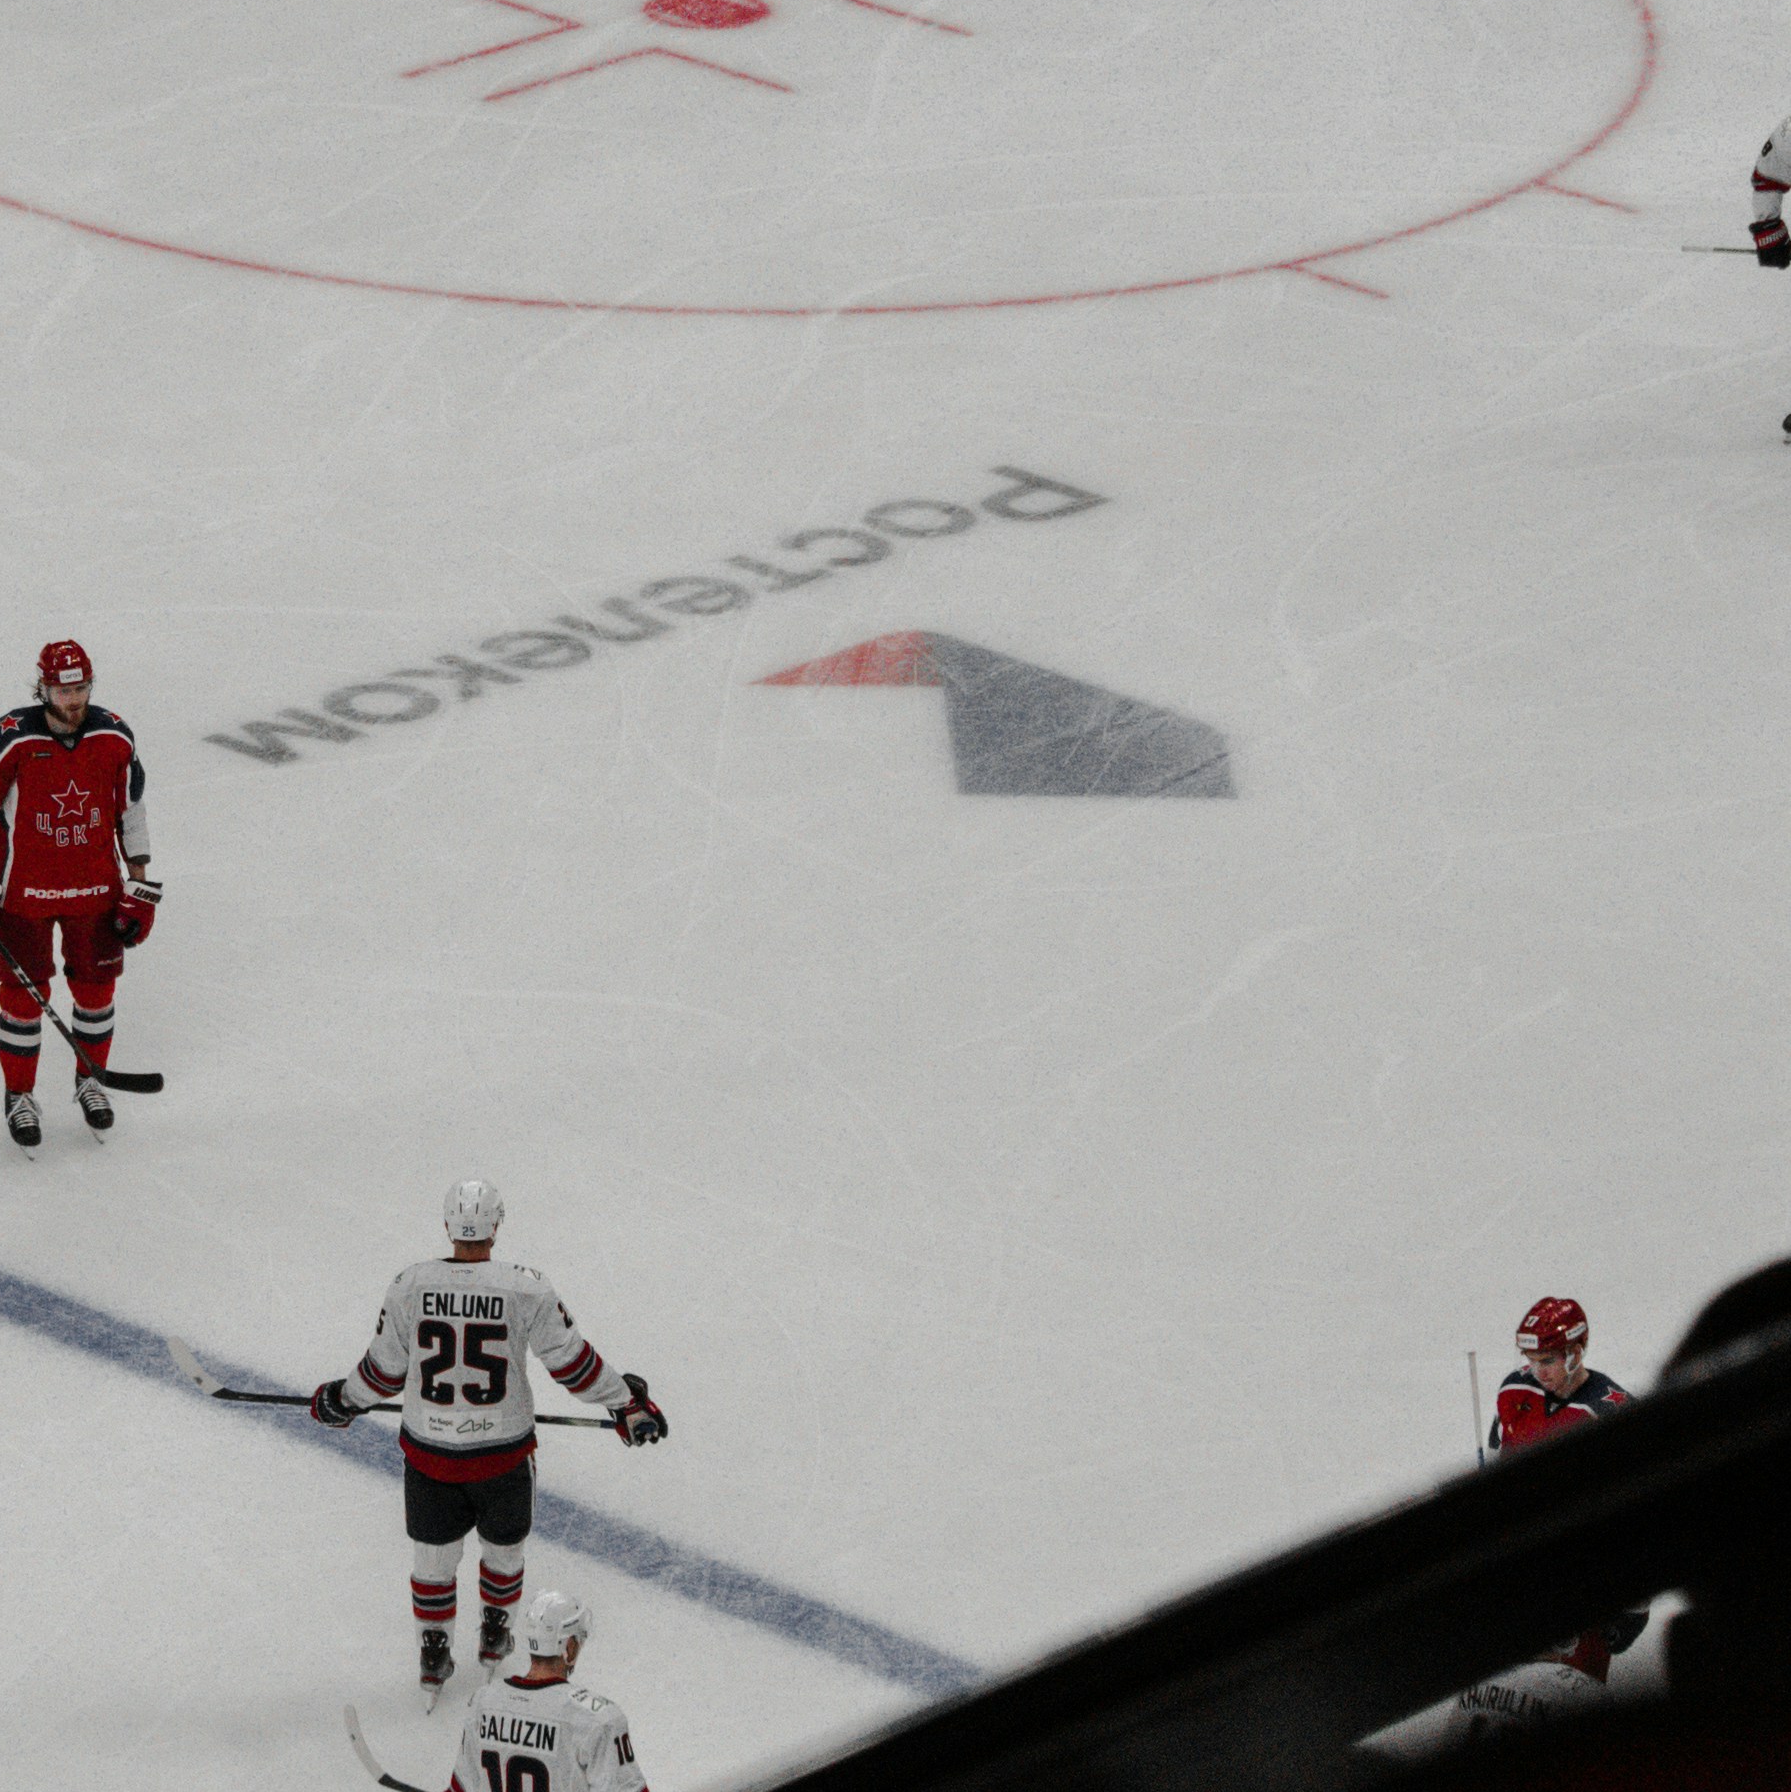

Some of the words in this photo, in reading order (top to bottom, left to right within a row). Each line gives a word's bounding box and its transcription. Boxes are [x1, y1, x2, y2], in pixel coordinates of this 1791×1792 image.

[202, 465, 1111, 768] Ростелеком
[35, 807, 103, 848] ЦСКА
[462, 1225, 477, 1237] 25
[422, 1291, 505, 1321] ENLUND
[417, 1319, 510, 1407] 25
[479, 1713, 557, 1752] GALUZIN
[614, 1731, 636, 1767] 10
